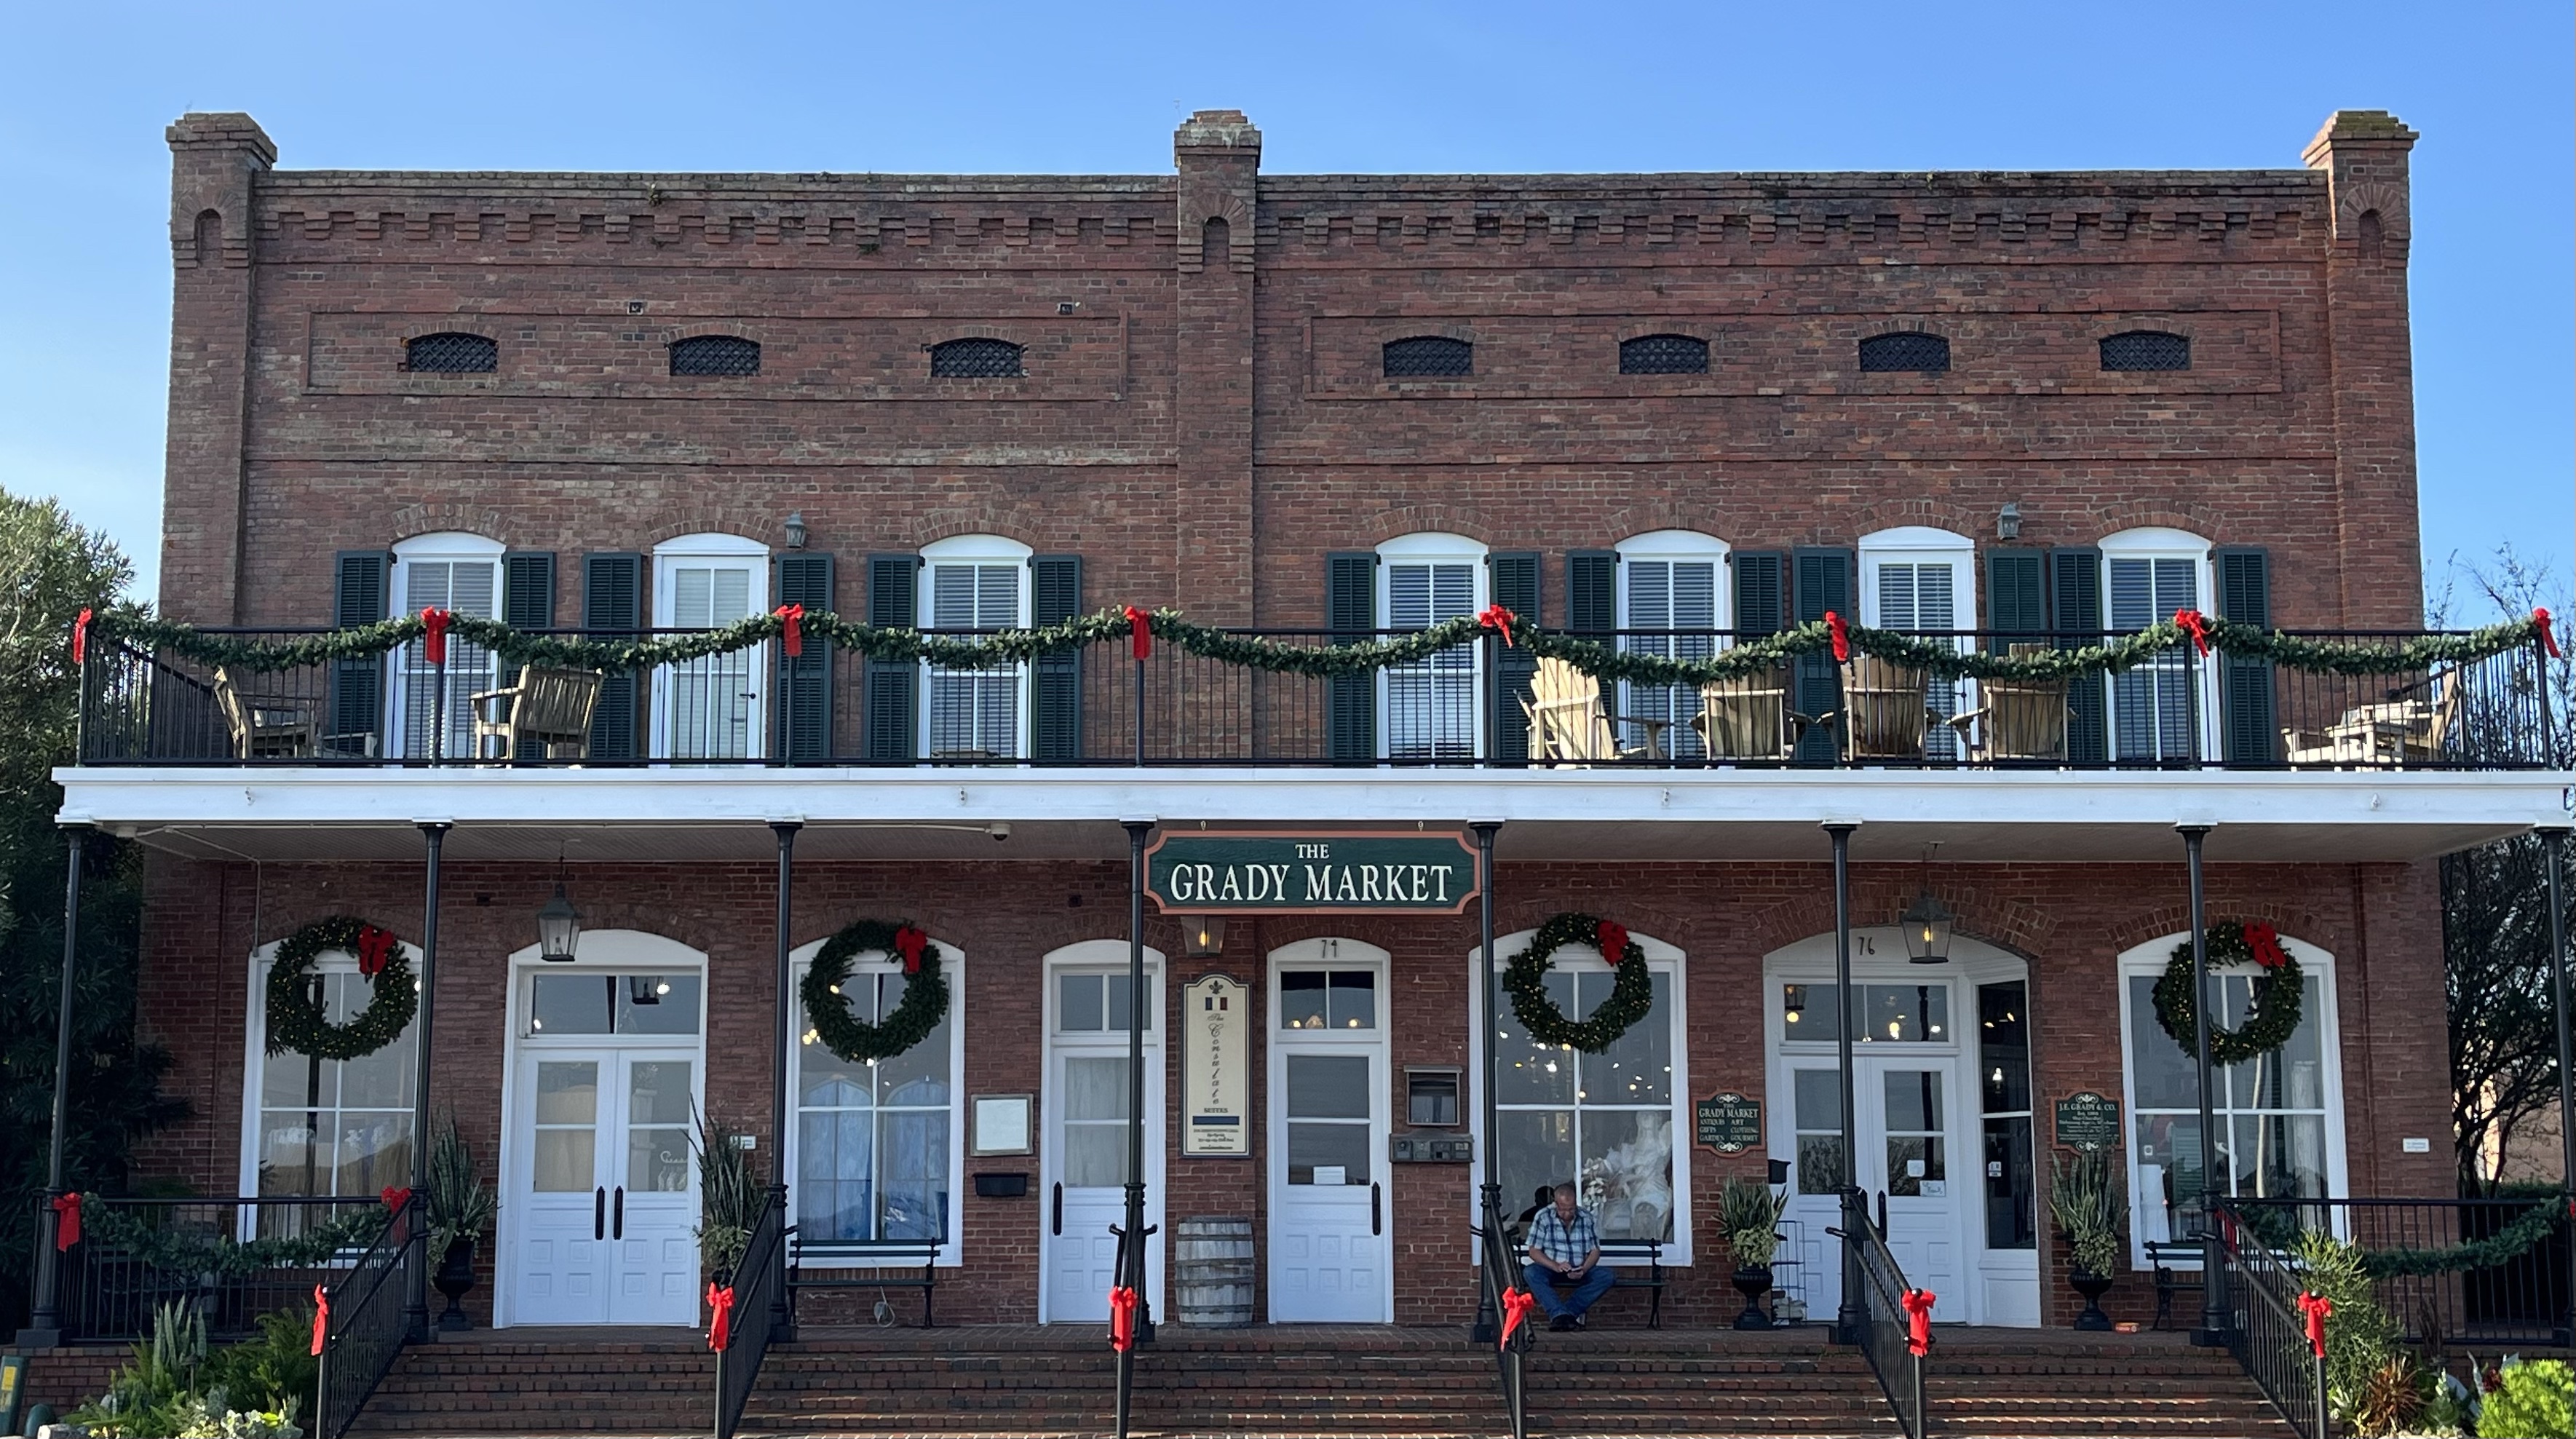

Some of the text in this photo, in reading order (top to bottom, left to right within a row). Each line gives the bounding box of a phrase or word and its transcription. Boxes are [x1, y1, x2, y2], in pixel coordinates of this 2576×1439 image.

[1295, 844, 1330, 860] THE
[1170, 863, 1453, 902] GRADY MARKET
[1858, 936, 1876, 956] 76
[1208, 1023, 1224, 1105] Consulate
[1698, 1108, 1759, 1119] GRADY MARKET
